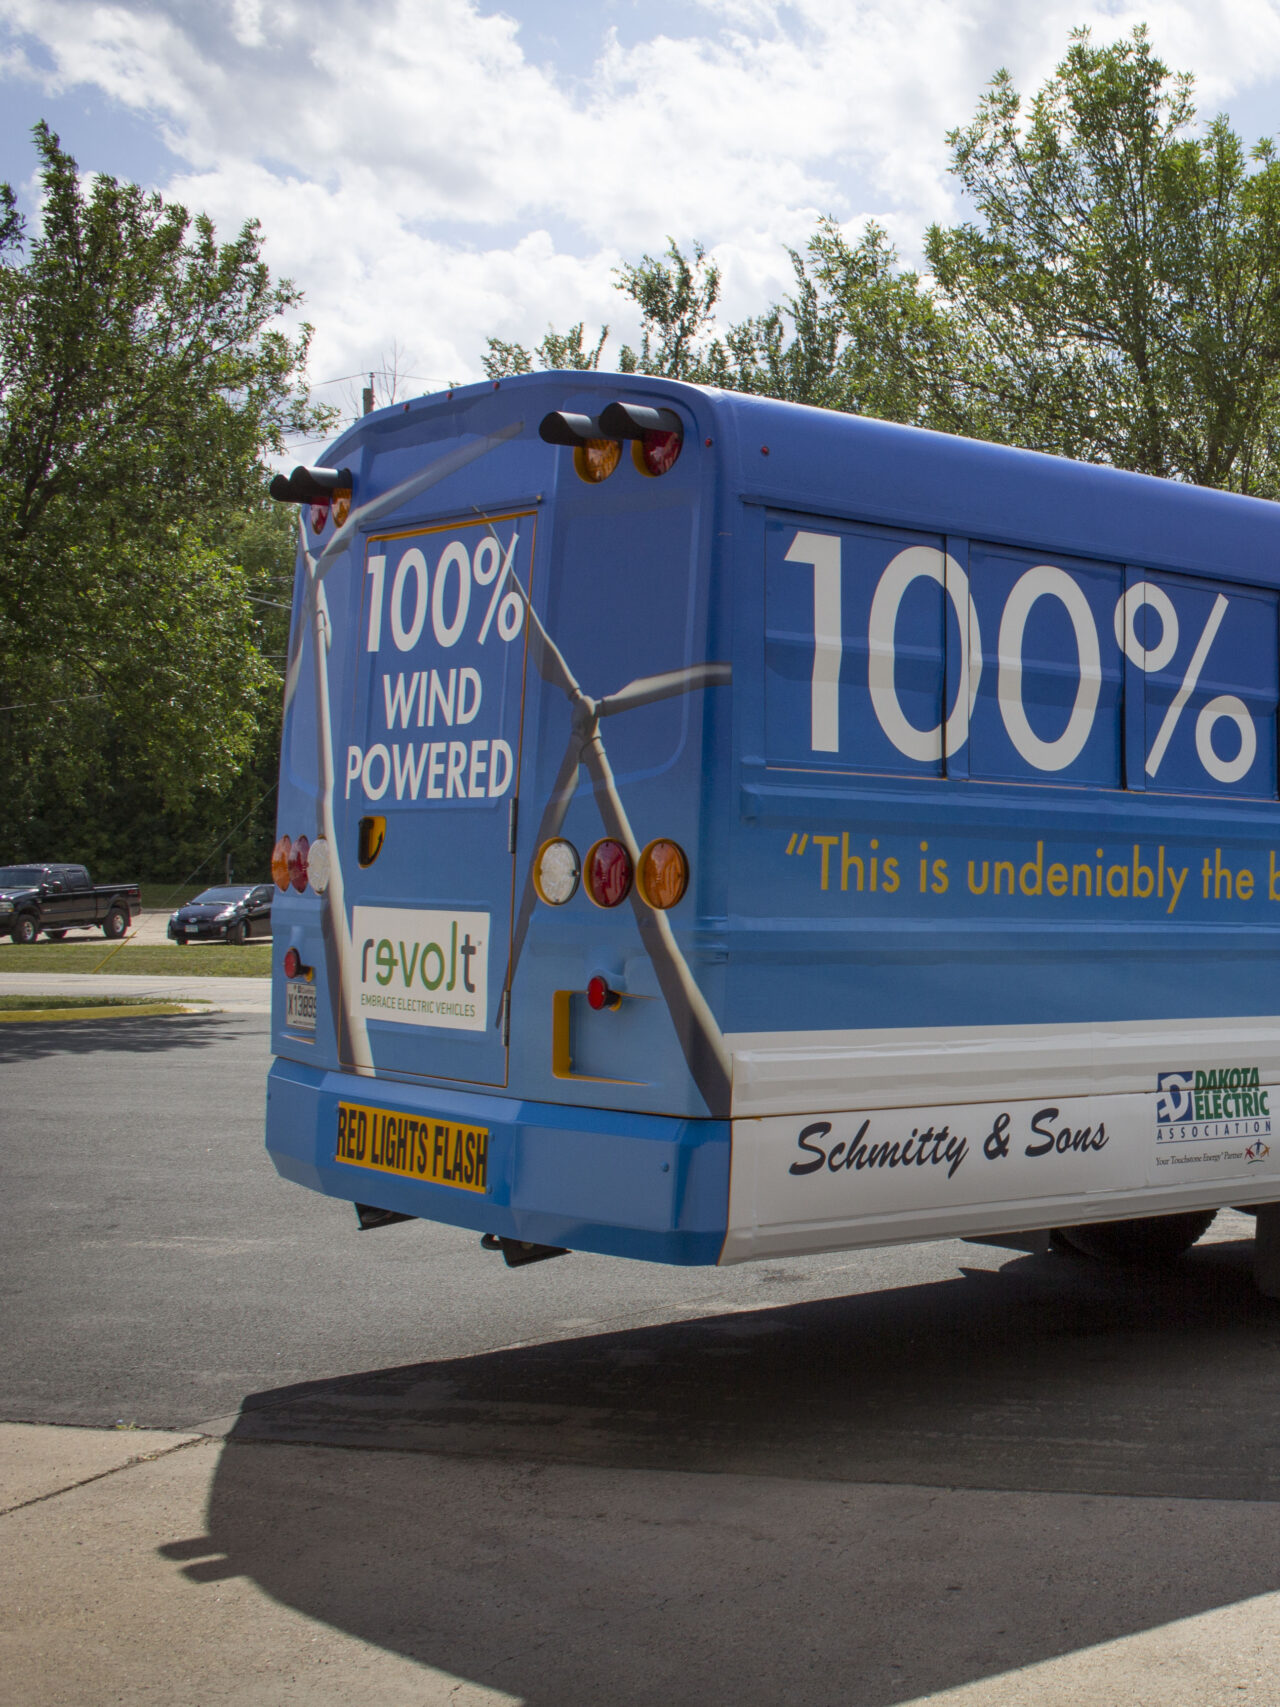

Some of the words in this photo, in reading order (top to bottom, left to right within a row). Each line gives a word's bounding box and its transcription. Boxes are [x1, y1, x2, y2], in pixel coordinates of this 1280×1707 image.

[367, 532, 524, 652] 100%
[784, 531, 1257, 783] 100%
[383, 667, 482, 729] WIND
[345, 739, 513, 801] POWERED
[920, 841, 948, 893] is
[967, 841, 1188, 913] undeniably
[1202, 848, 1255, 900] the
[361, 920, 476, 993] revolt
[361, 993, 396, 1009] EMBRACE
[397, 998, 434, 1013] ELECTRIC
[435, 1000, 475, 1017] VEHICLES
[1194, 1067, 1259, 1095] DAKOTA
[1194, 1091, 1270, 1120] ELECTRIC
[337, 1107, 367, 1161] RED
[371, 1113, 428, 1174] LIGHTS
[432, 1125, 489, 1188] FLASH
[788, 1119, 969, 1179] Schmitty
[983, 1112, 1011, 1160] &
[1025, 1107, 1110, 1157] Sons
[1157, 1121, 1271, 1140] ASSOCIATION
